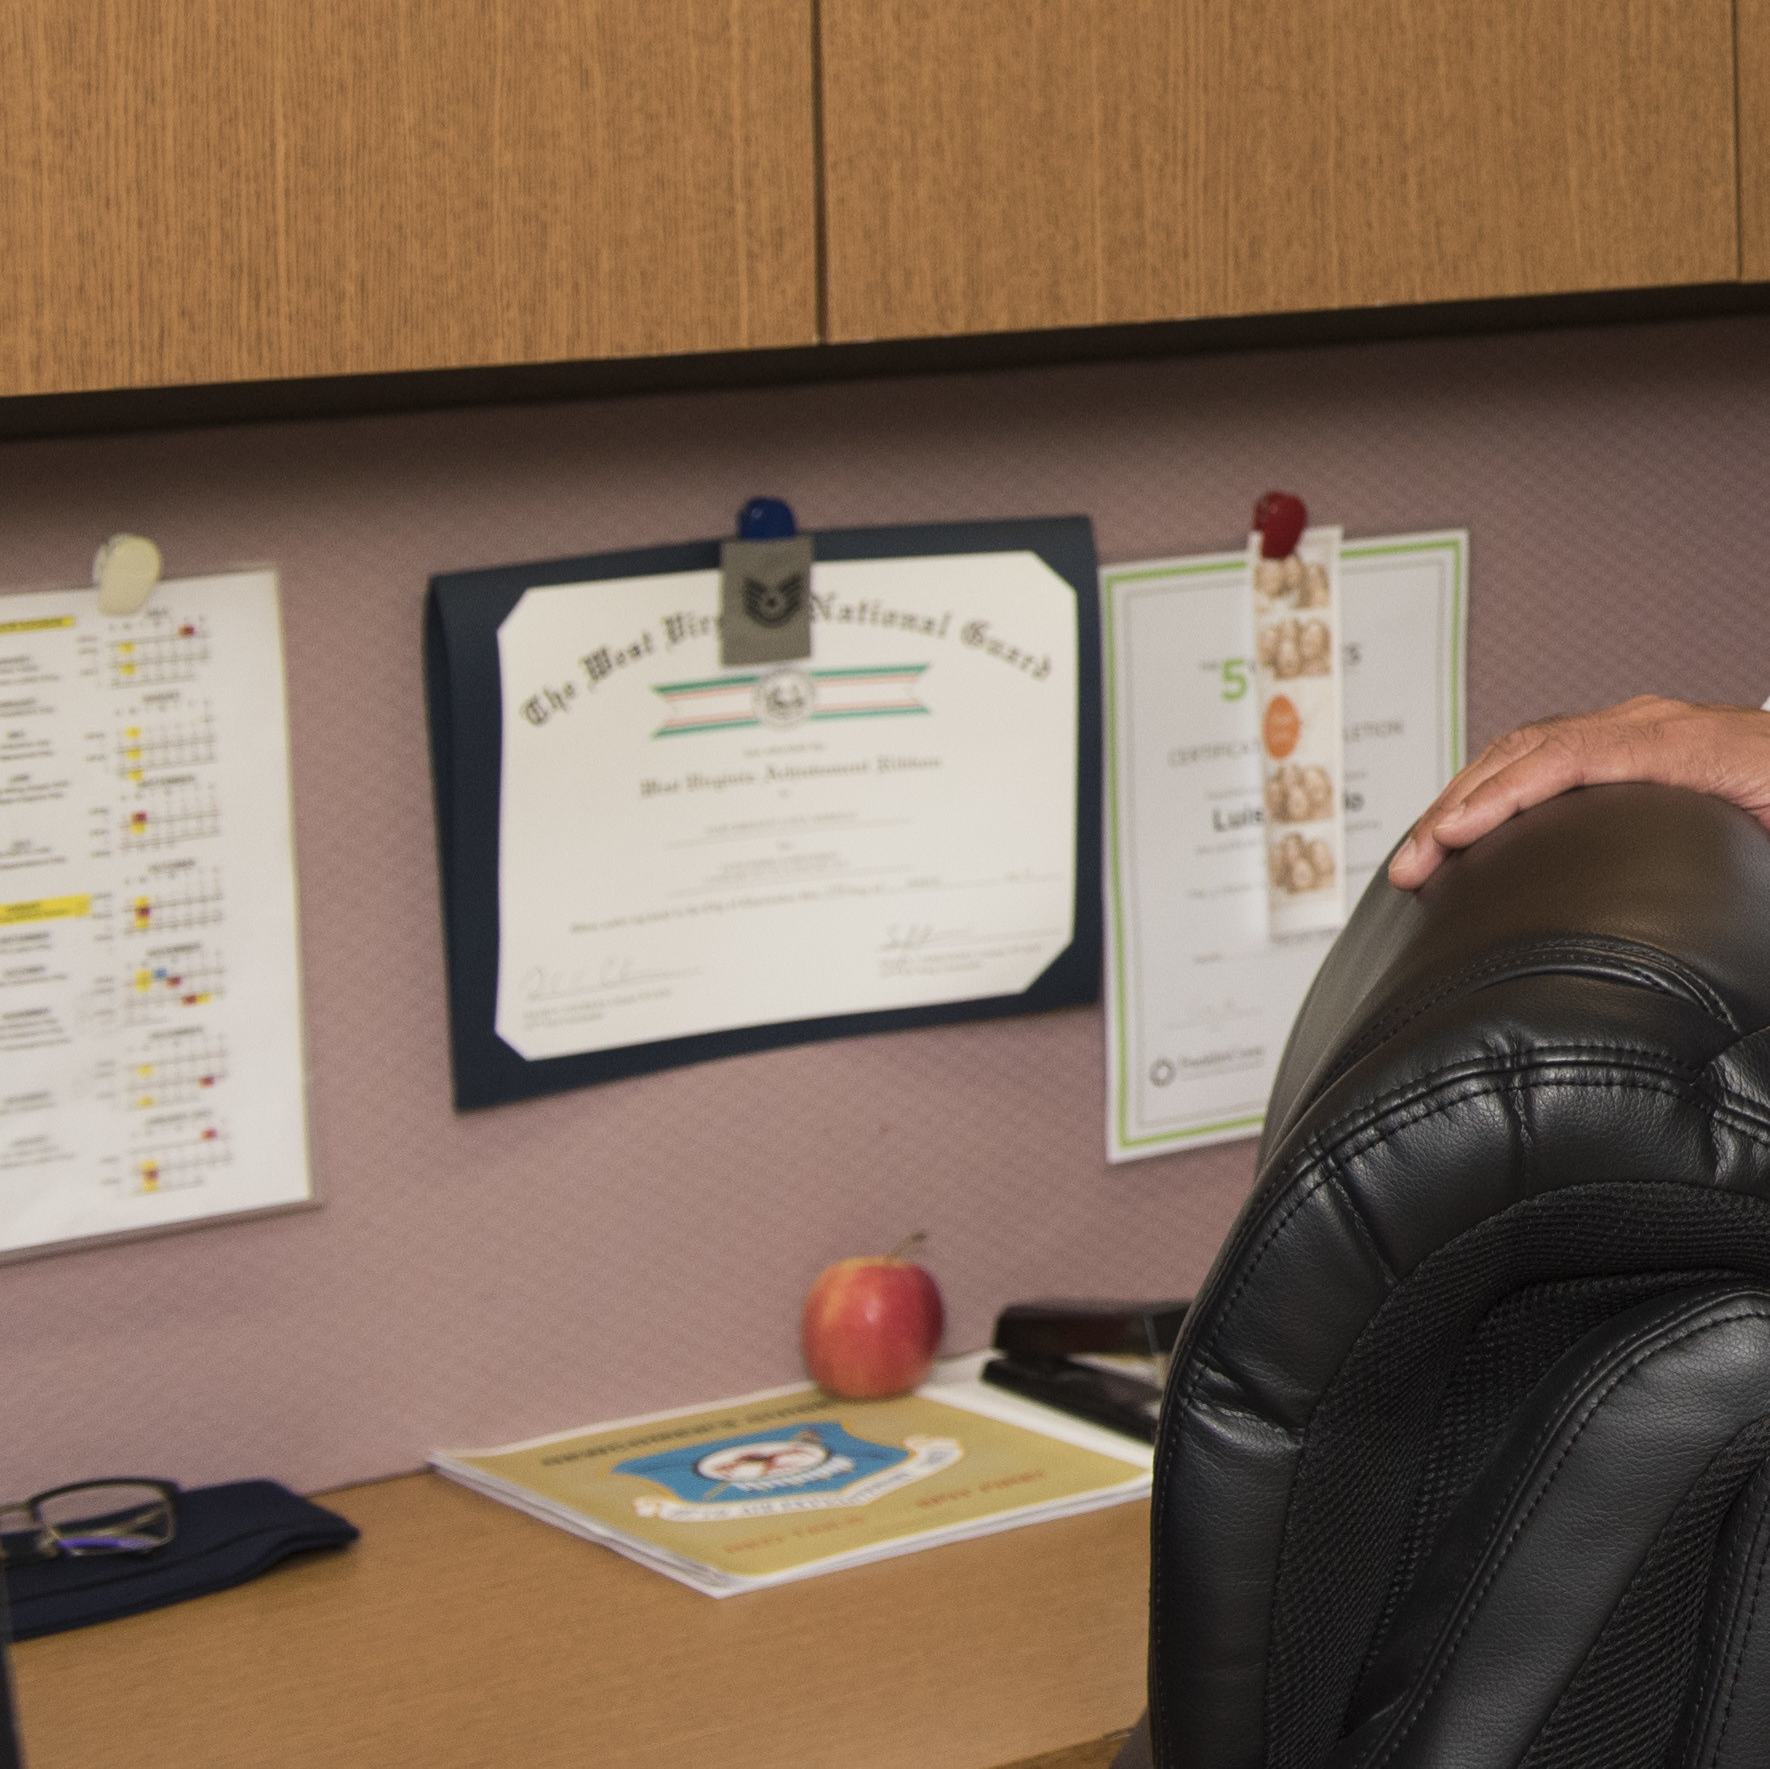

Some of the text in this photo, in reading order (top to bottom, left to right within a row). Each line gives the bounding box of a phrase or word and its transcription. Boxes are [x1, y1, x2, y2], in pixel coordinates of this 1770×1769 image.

[519, 681, 577, 727] The
[579, 631, 655, 692] West
[811, 591, 954, 640] National
[959, 619, 1053, 681] Guard
[1220, 657, 1248, 701] 5
